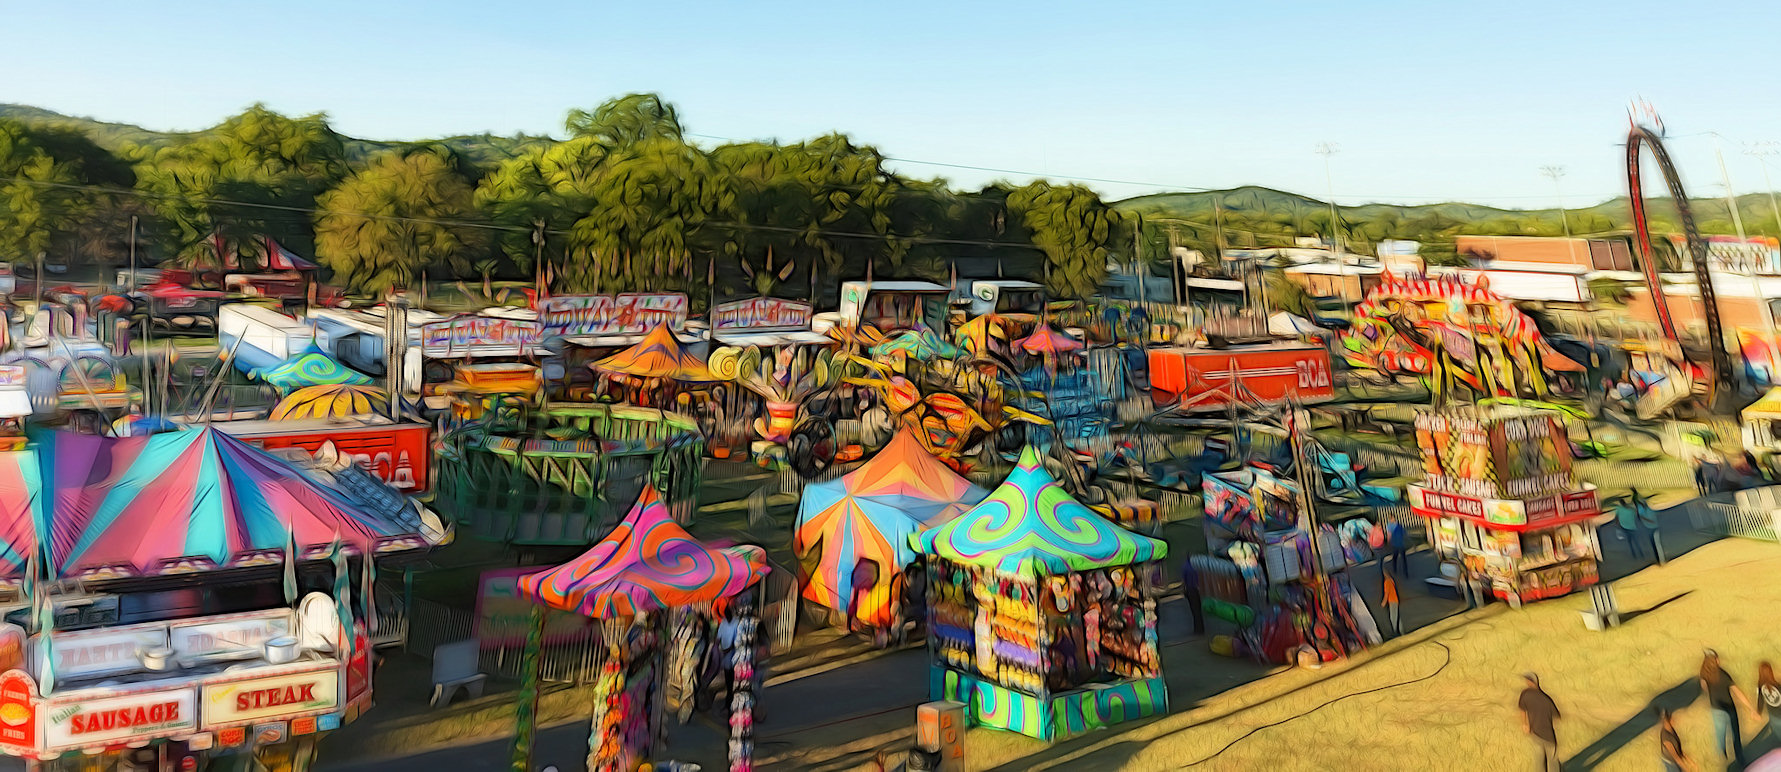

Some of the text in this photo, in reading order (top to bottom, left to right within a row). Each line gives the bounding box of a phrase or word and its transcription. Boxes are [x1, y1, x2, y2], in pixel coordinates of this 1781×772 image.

[1439, 271, 1468, 285] ZONE
[1460, 477, 1498, 498] SAUSAGE
[1457, 498, 1482, 517] CAKES
[236, 682, 317, 712] STEAK
[51, 704, 82, 725] Italian
[70, 701, 179, 735] SAUSAGE
[3, 729, 25, 740] FRIES
[220, 729, 244, 739] CORN
